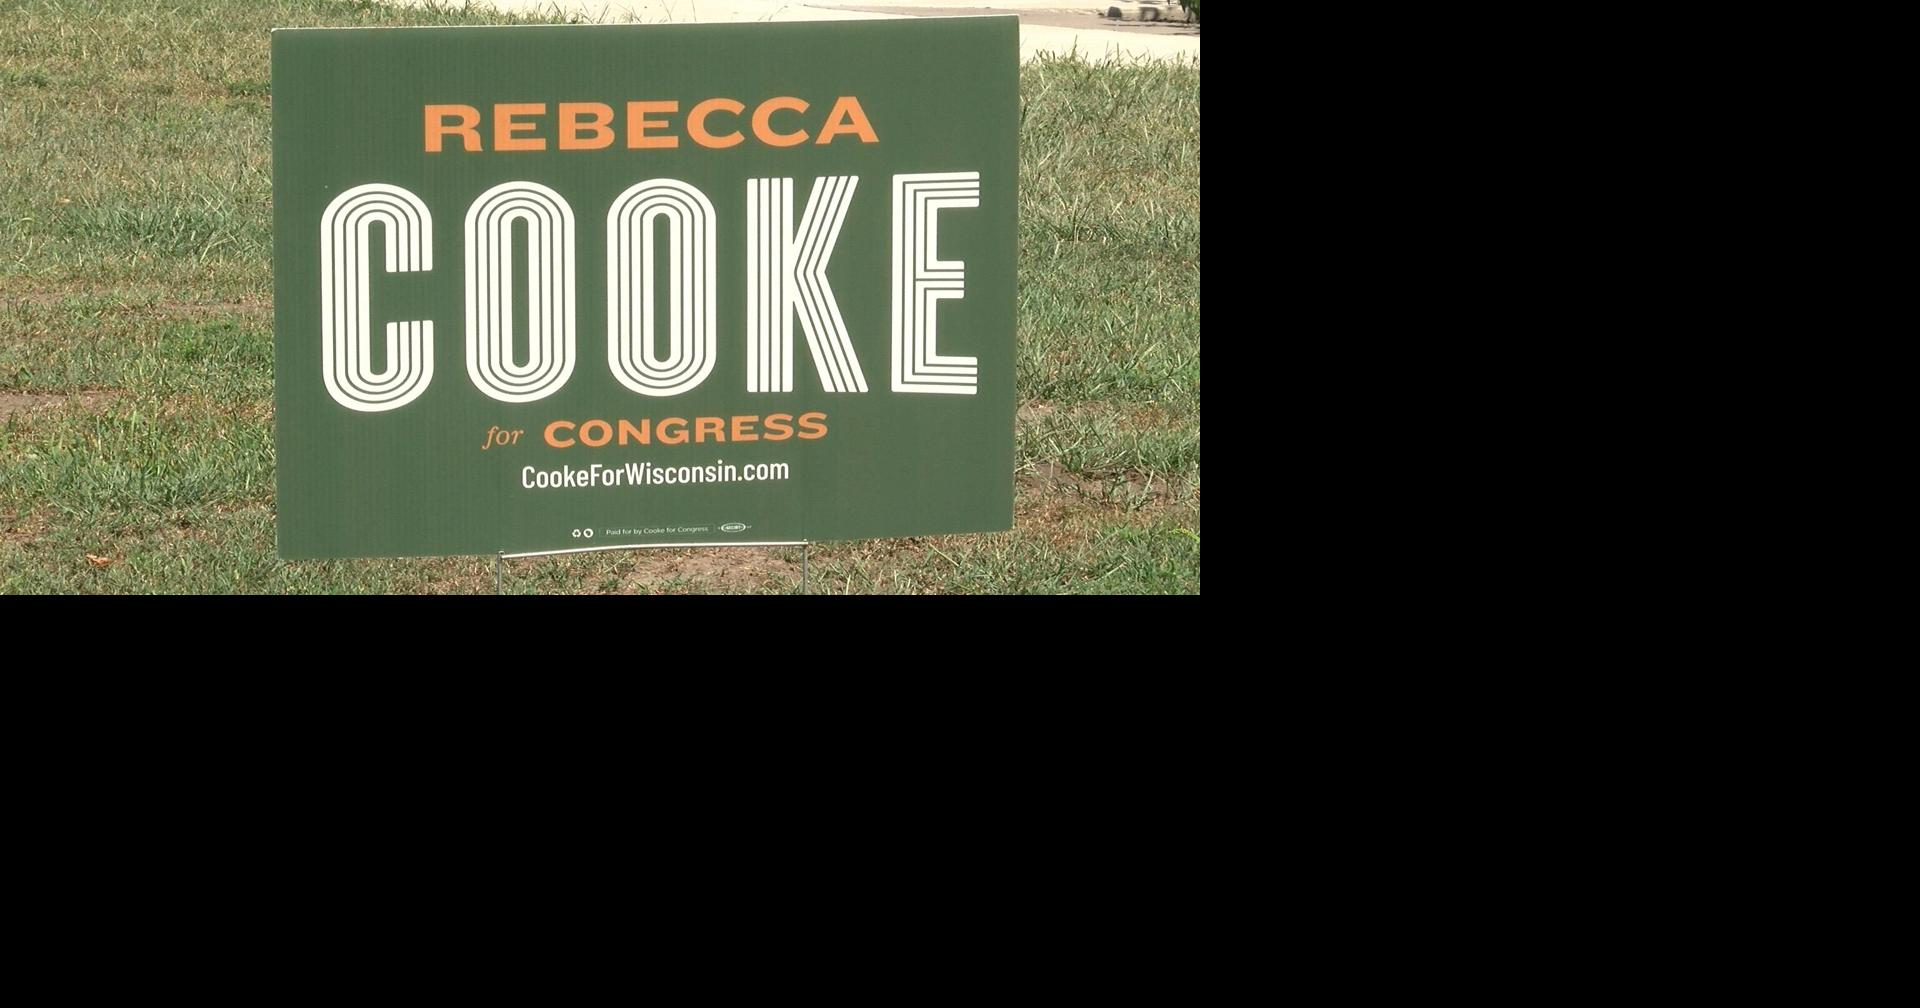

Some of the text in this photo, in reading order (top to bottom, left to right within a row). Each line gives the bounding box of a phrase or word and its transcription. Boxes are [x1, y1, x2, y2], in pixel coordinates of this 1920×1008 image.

[425, 96, 879, 153] REBECCA
[321, 172, 980, 412] COOKE
[482, 412, 828, 450] for CONGRESS
[522, 459, 789, 489] CookeForWisconsin.com
[606, 528, 621, 536] Paid
[633, 528, 643, 536] by
[644, 527, 666, 535] Cooke
[678, 526, 709, 534] Congress
